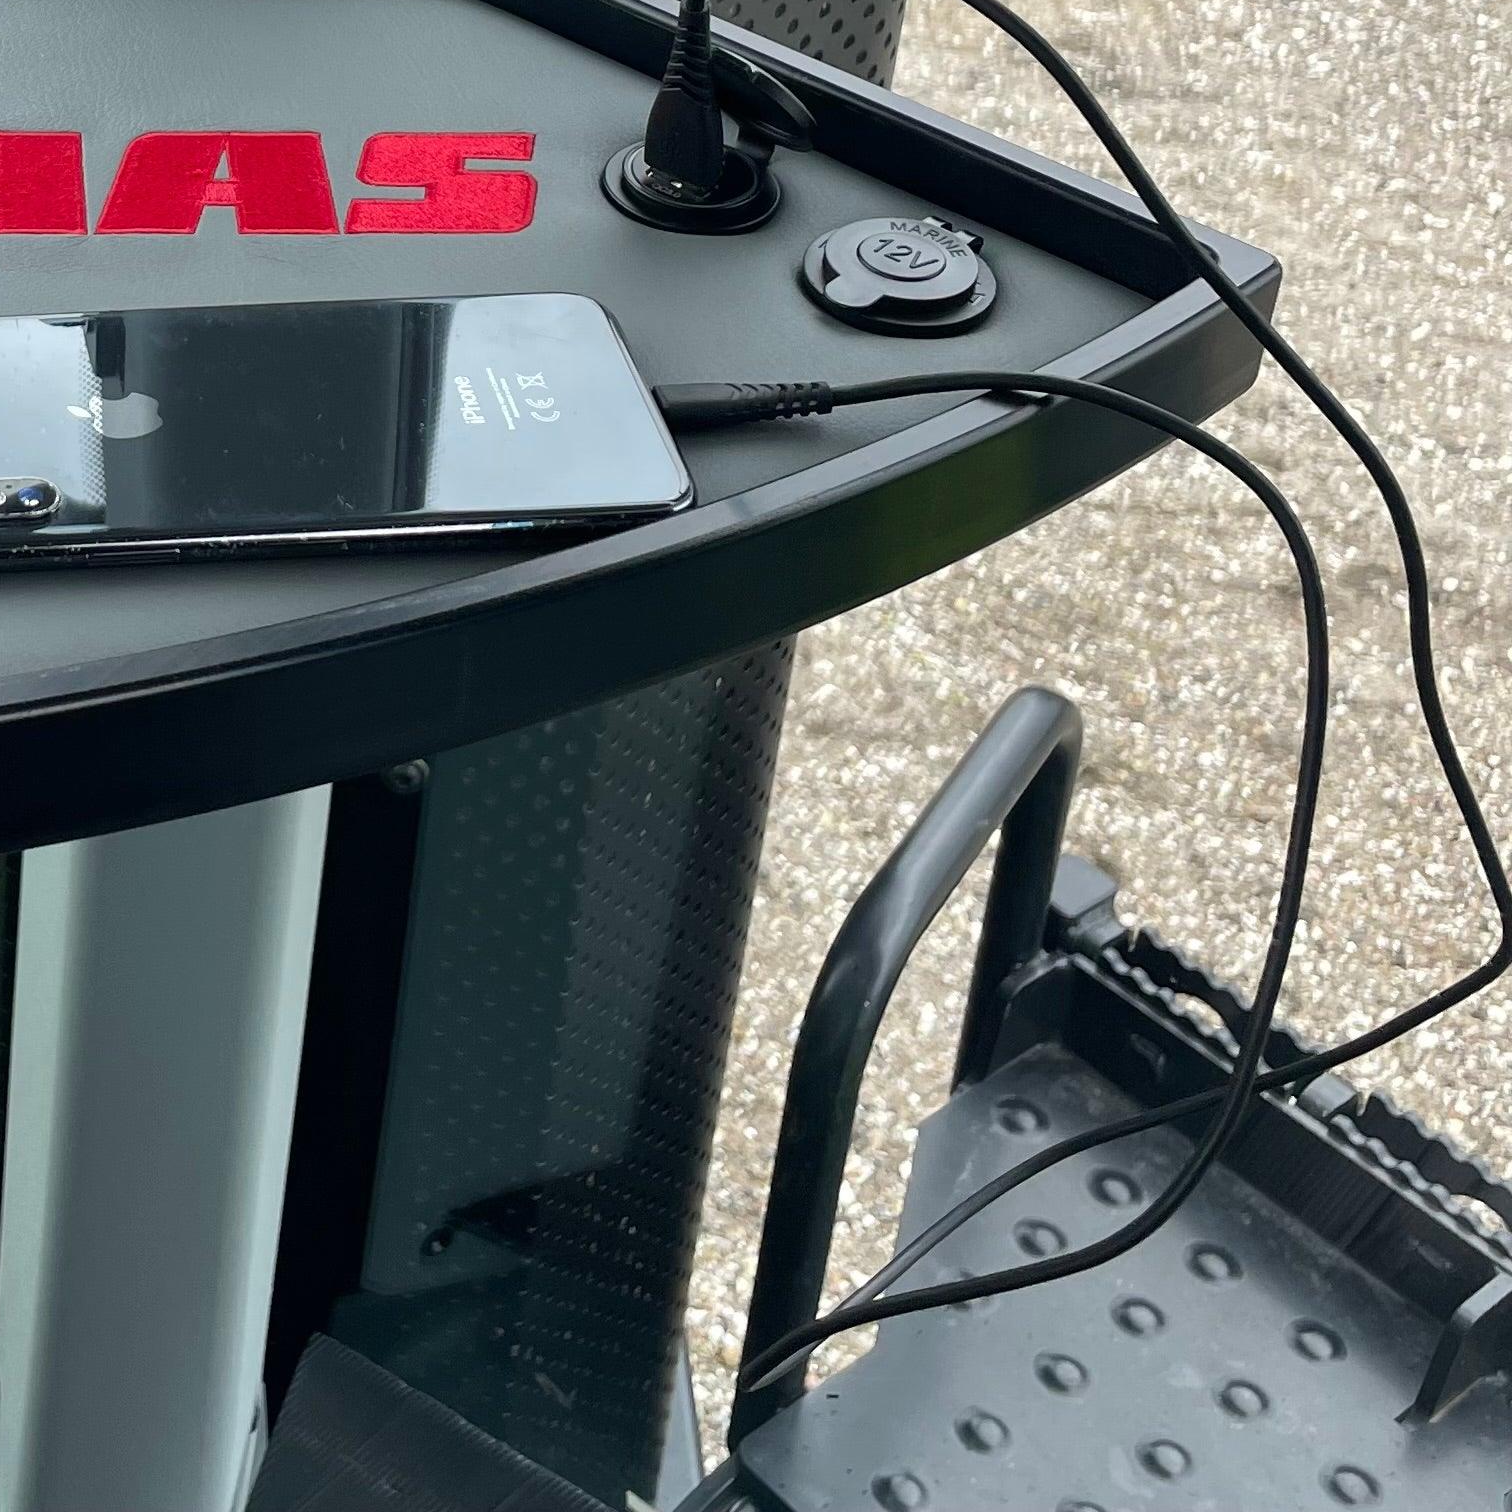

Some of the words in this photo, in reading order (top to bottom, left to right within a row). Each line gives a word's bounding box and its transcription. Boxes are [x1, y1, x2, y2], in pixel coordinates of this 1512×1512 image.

[873, 238, 940, 269] 12V
[890, 221, 968, 259] MARINE
[454, 375, 486, 424] iPhone
